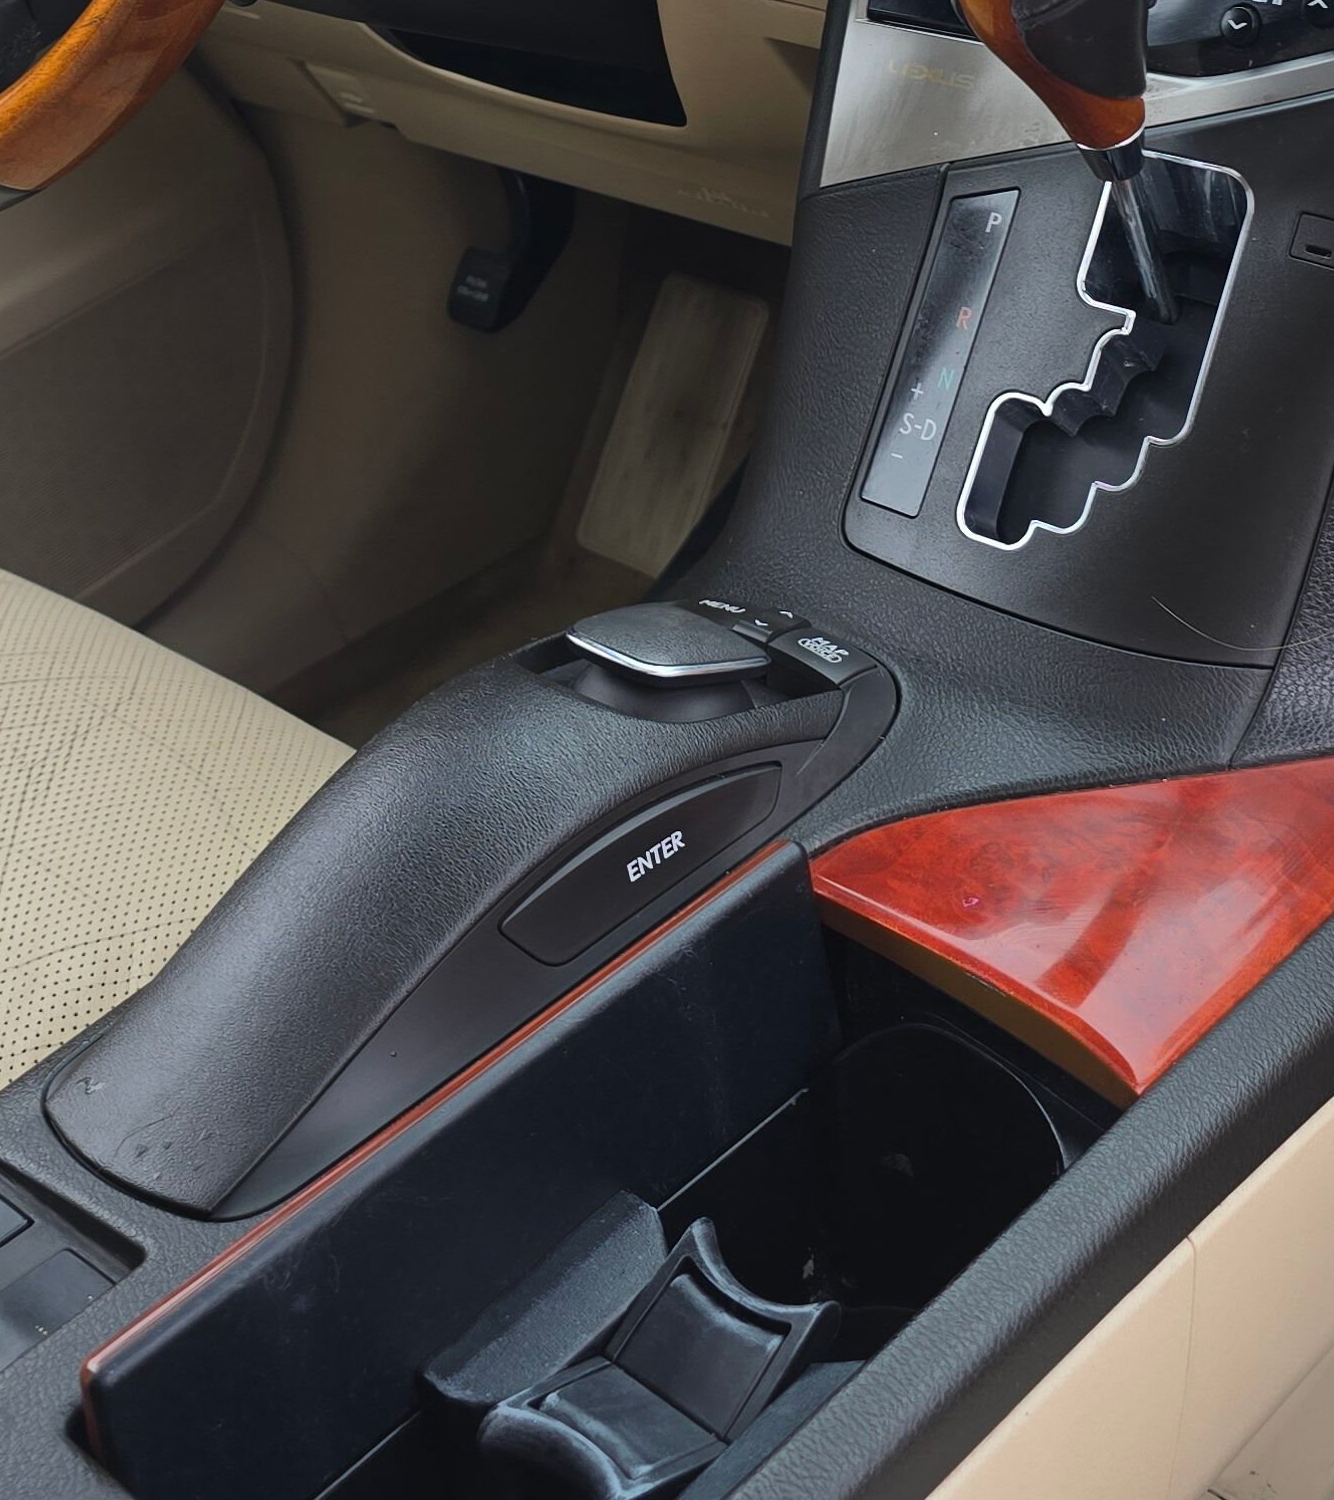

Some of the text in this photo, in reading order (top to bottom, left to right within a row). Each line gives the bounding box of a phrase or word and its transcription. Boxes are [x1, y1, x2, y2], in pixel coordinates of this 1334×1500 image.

[983, 211, 1003, 233] P
[956, 305, 973, 330] R
[937, 367, 955, 390] N
[698, 599, 746, 613] MENU
[626, 830, 686, 882] ENTER
